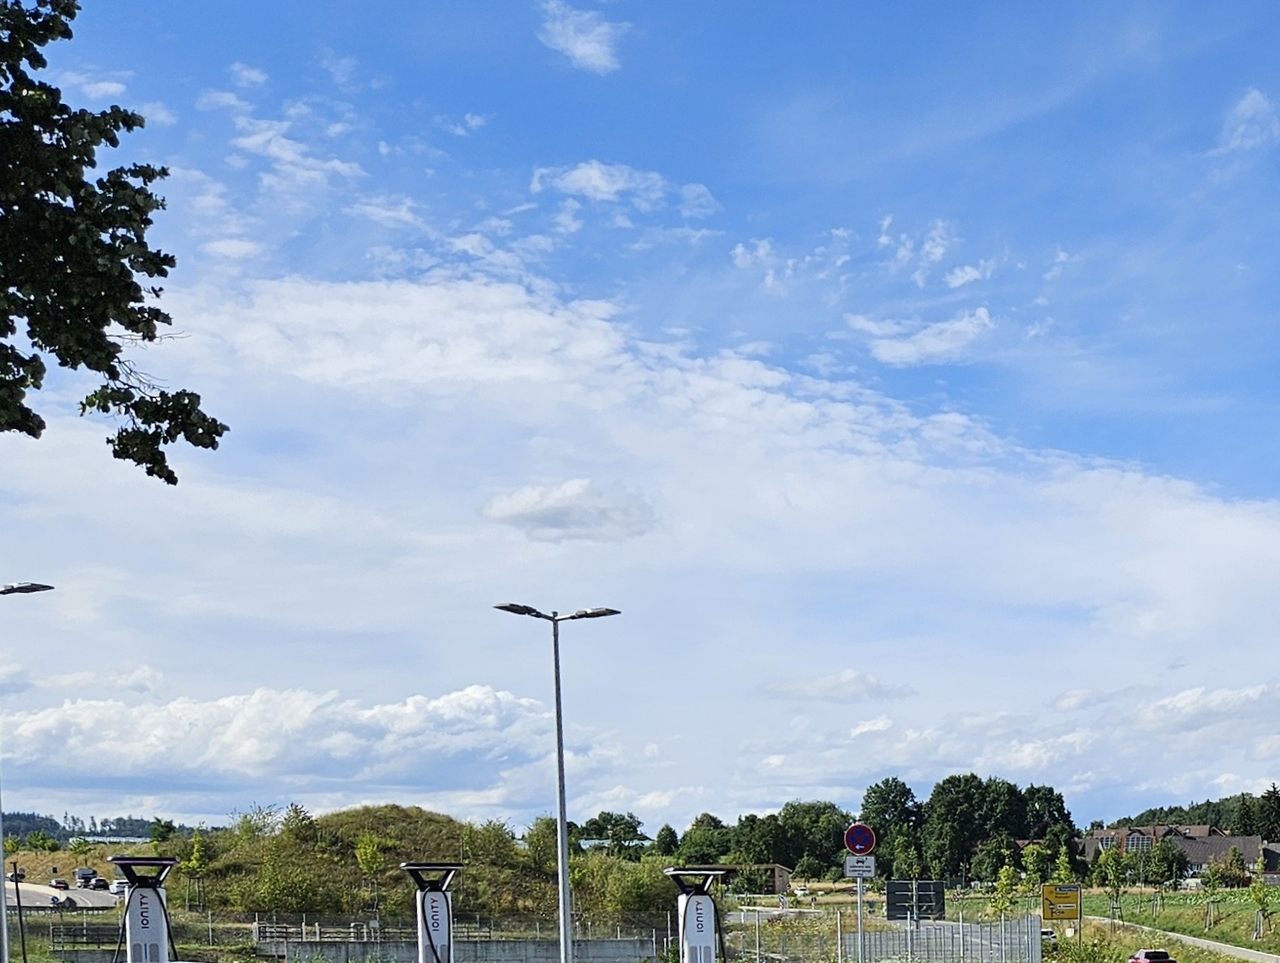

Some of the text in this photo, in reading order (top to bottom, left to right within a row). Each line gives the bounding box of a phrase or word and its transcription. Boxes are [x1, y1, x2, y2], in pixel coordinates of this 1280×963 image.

[140, 893, 150, 929] IONITY
[430, 897, 440, 932] IONITY
[695, 900, 704, 933] IONITY
